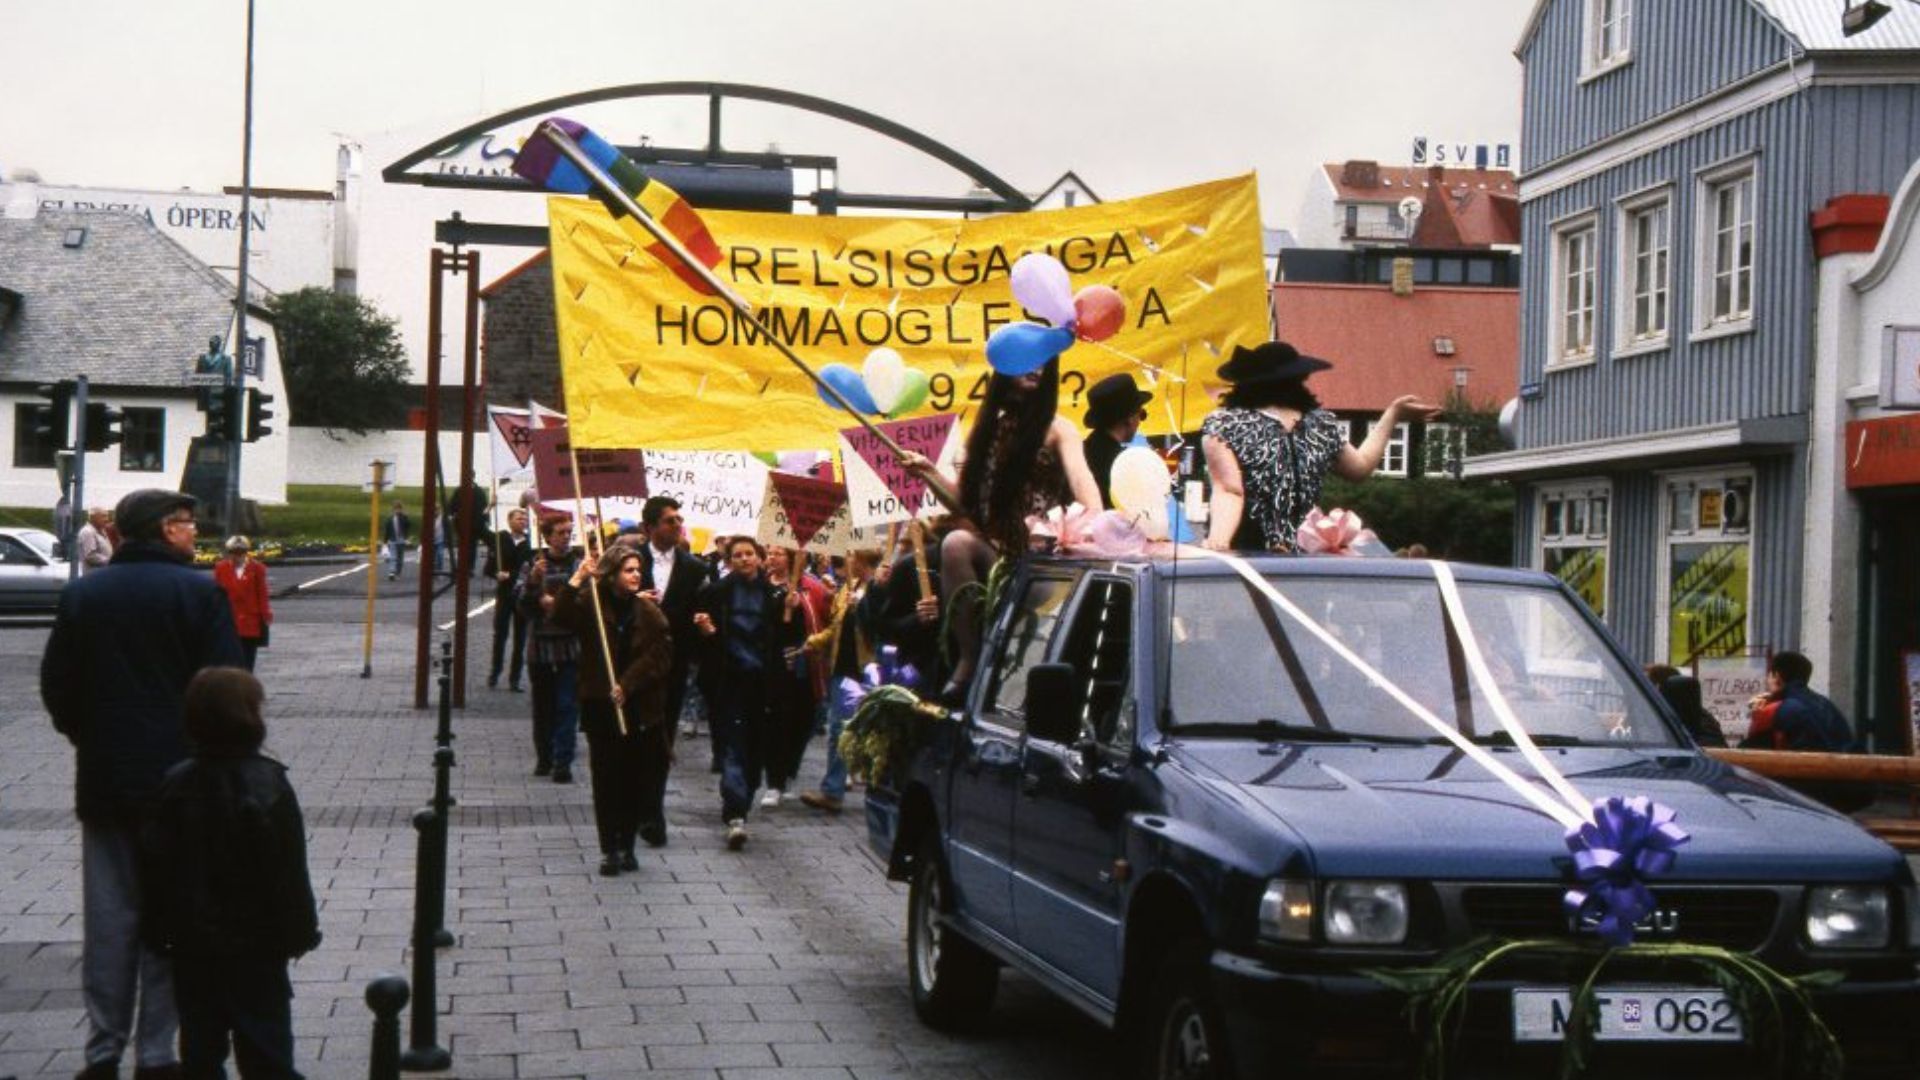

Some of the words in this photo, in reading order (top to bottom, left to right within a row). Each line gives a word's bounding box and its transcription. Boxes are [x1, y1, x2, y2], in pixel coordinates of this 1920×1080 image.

[730, 232, 1134, 289] RELSISGAGA
[691, 493, 762, 519] HOMM
[868, 493, 937, 515] MÖNNU
[1623, 1003, 1641, 1020] 96
[1655, 998, 1738, 1035] 062
